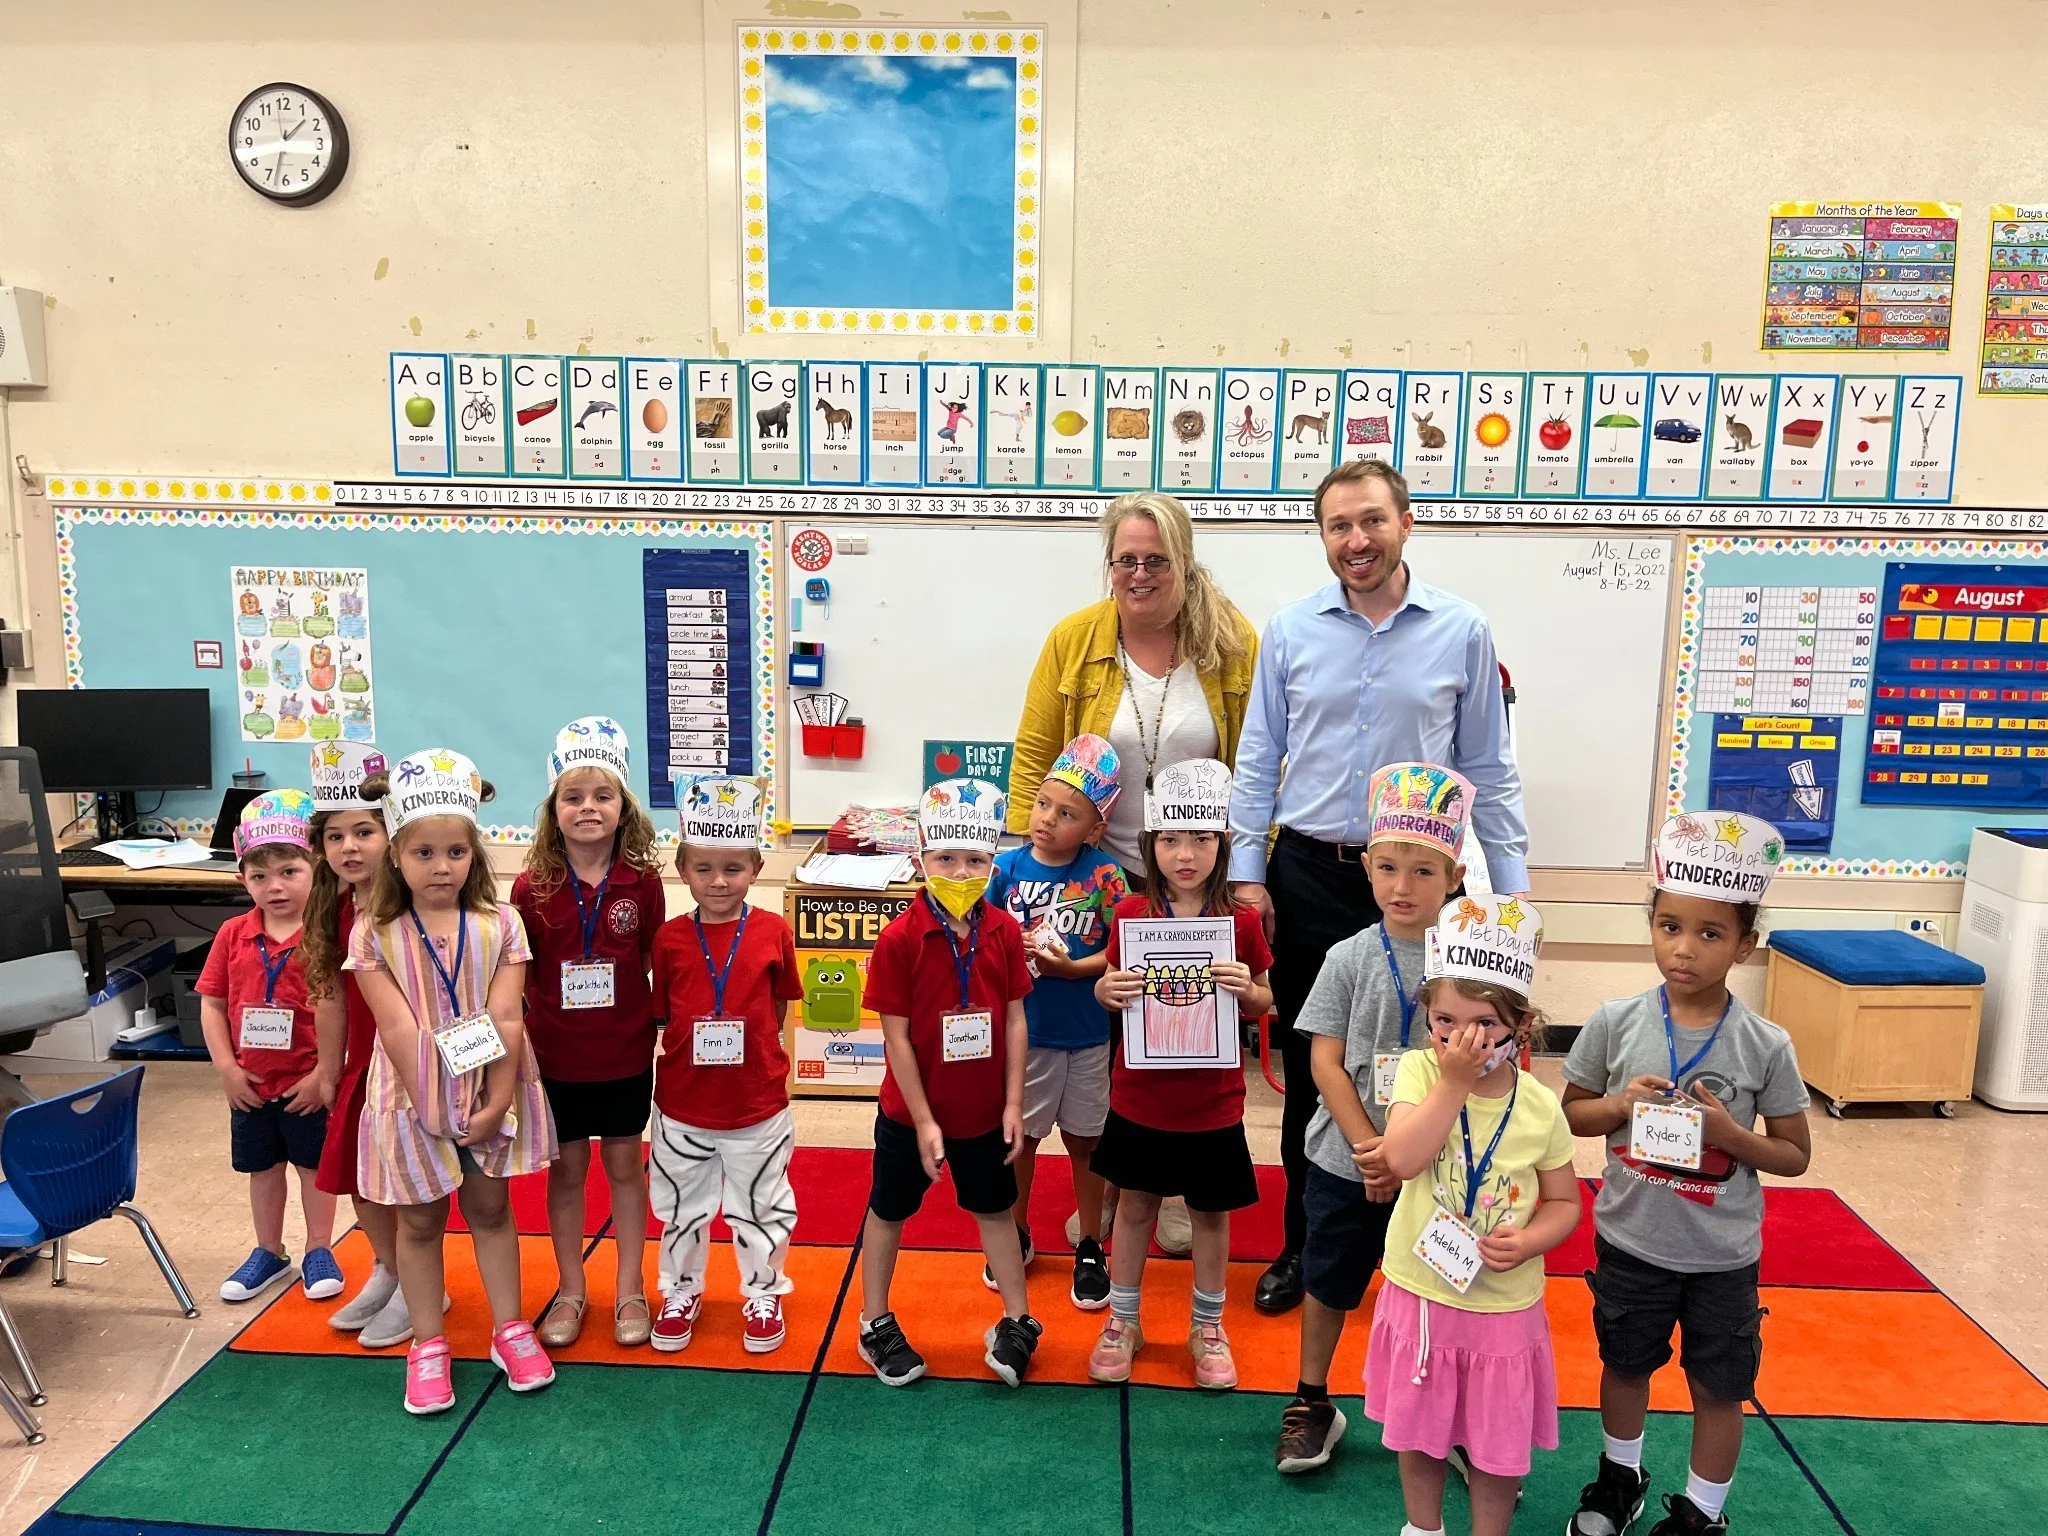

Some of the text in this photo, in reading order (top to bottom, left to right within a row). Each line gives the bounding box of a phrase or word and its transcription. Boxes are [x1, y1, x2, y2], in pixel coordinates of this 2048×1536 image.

[276, 97, 291, 110] 12
[260, 103, 271, 116] 11
[299, 103, 305, 116] 1
[246, 118, 260, 131] 10
[312, 118, 321, 131] 2
[282, 174, 290, 186] 6
[1816, 205, 1918, 216] Months of the Year
[2017, 208, 2042, 220] Days
[1801, 223, 1837, 235] January
[1891, 224, 1932, 236] February
[1803, 246, 1833, 256] March
[1899, 246, 1920, 256] April
[1807, 266, 1826, 277] May
[1899, 268, 1920, 278] June
[1804, 286, 1822, 298] July
[1891, 287, 1921, 298] August
[1790, 311, 1837, 322] September
[1886, 311, 1925, 322] October
[1787, 334, 1832, 344] November
[1881, 333, 1925, 343] December
[408, 434, 434, 443] apple
[464, 434, 496, 444] bicycle
[524, 436, 551, 444] canoe
[580, 437, 613, 446] dolphin
[646, 440, 664, 449] egg
[704, 441, 726, 449] fossil
[761, 442, 789, 451] gorilla
[823, 442, 848, 451] horse
[885, 444, 904, 452] inch
[940, 445, 964, 455] jump
[997, 445, 1026, 454] karate
[1055, 446, 1082, 455] lemon
[1117, 450, 1137, 459] map
[1229, 450, 1265, 460] octopus
[1294, 452, 1320, 460] puma
[1415, 454, 1443, 462] rabbit
[1537, 455, 1569, 463] tomato
[1594, 455, 1634, 464] umbrella
[1719, 457, 1755, 467] wallaby
[1910, 458, 1939, 468] zipper
[475, 490, 488, 503] 10
[714, 494, 730, 507] 23
[928, 499, 944, 512] 33
[1214, 501, 1231, 514] 46
[1463, 505, 1480, 519] 57
[1618, 508, 1636, 522] 64
[794, 532, 830, 557] KENTWOOD
[1592, 540, 1661, 561] Ms. Lee
[794, 552, 824, 570] KOALAS
[1562, 562, 1666, 580] August 15, 2022
[236, 568, 364, 591] HAPPY BIRTHDAY
[1600, 578, 1651, 590] 8-15-22
[669, 593, 692, 601] arrival
[1745, 592, 1758, 603] 10
[1800, 592, 1817, 604] 30
[1859, 592, 1876, 604] 50
[1955, 587, 2025, 610] August
[1742, 612, 1758, 624] 20
[670, 630, 691, 638] circle
[1794, 655, 1813, 666] 100
[670, 669, 691, 677] aloud
[670, 698, 689, 706] quiet
[1791, 698, 1808, 708] 160
[672, 715, 697, 723] carpet
[1754, 721, 1801, 729] Let's Count
[672, 733, 699, 741] project
[1720, 737, 1750, 745] Hundreds
[965, 745, 1006, 765] FIRST
[1911, 746, 1923, 754] 22
[671, 754, 702, 762] pack up
[325, 767, 363, 784] Day of
[967, 765, 1002, 777] DAY OF
[436, 773, 460, 790] Day
[1178, 786, 1216, 804] 1st Day
[698, 805, 753, 820] 1st Day of
[939, 806, 994, 822] 1st Day of
[1686, 841, 1762, 869] 1st Day of
[1666, 860, 1767, 893] KINDERGARTEN
[1012, 881, 1066, 907] JUST
[800, 898, 891, 913] How to Be a
[1045, 909, 1095, 936] DO IT
[1139, 930, 1217, 942] I AM A CRAYON EXPERT
[1470, 925, 1534, 956] 1st Day of
[603, 981, 609, 989] N
[246, 1023, 277, 1032] Jackson
[948, 1029, 987, 1043] Jonathan T
[451, 1035, 488, 1058] Isabella
[703, 1037, 733, 1048] Finn D
[799, 1062, 823, 1071] FEET
[1645, 1125, 1681, 1145] Ryder
[1622, 1167, 1728, 1195] PISTON CUP RACING SERIES
[1429, 1229, 1460, 1260] Adeleh
